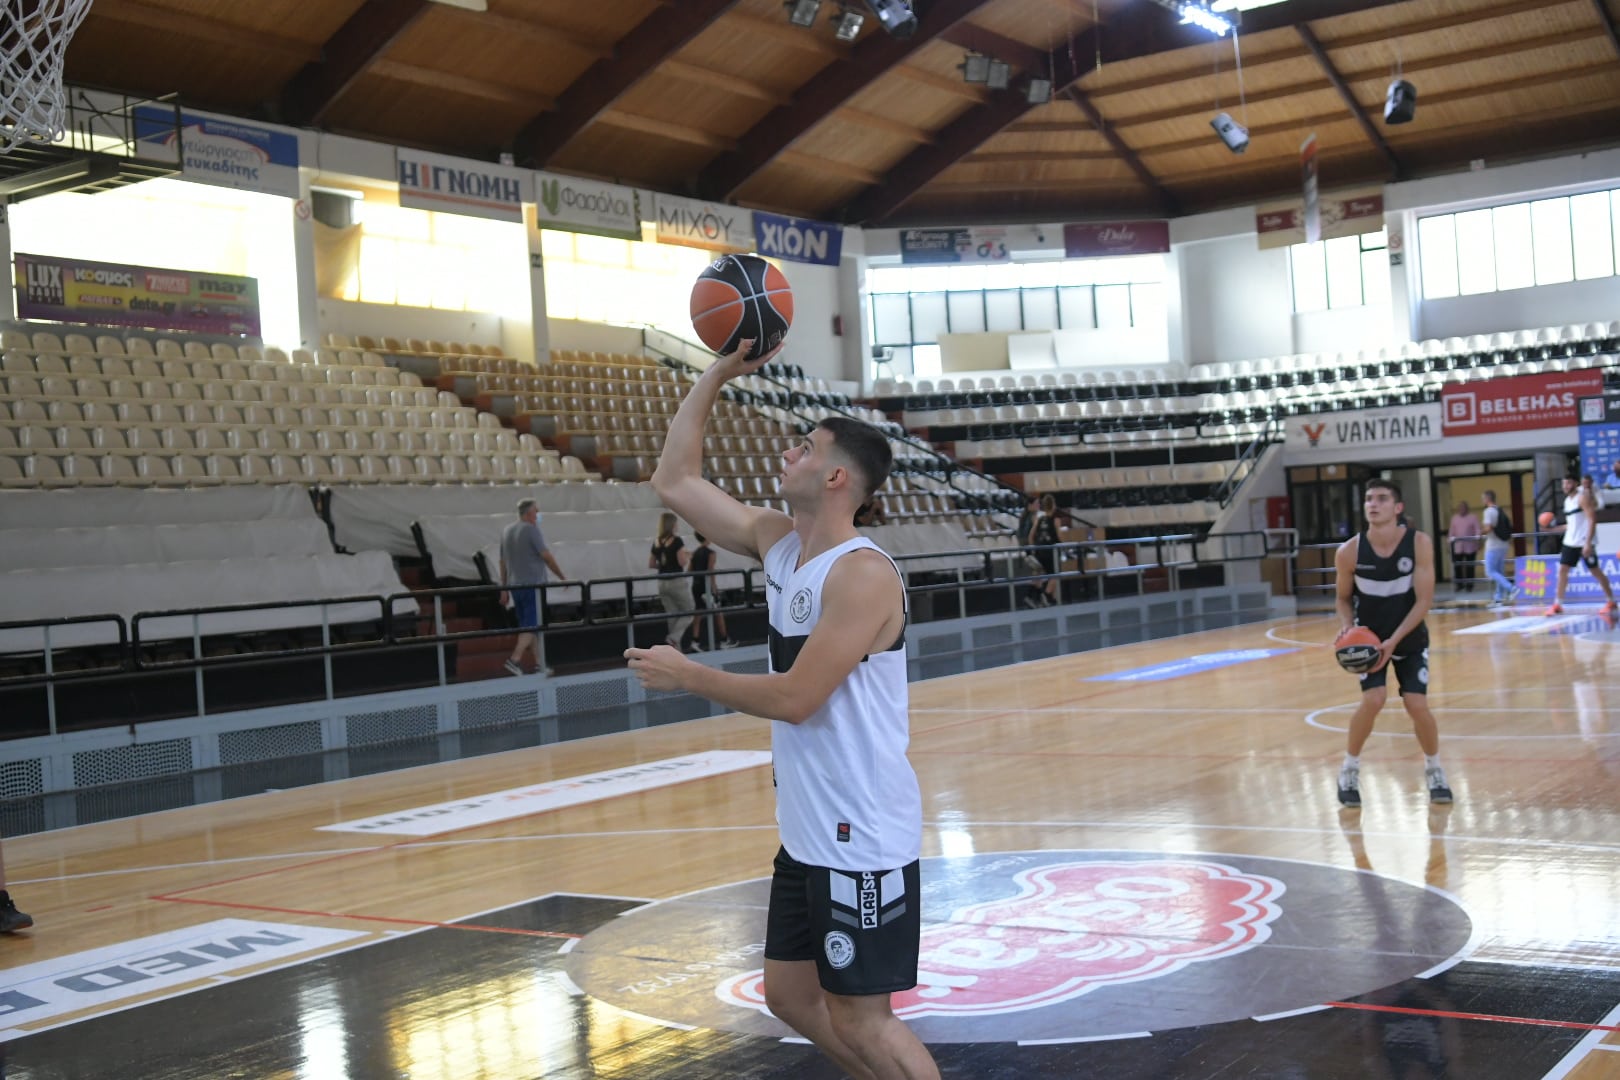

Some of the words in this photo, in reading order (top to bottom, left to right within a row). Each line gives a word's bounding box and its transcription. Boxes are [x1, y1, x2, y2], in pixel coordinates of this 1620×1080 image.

[183, 156, 259, 180] ευκαδίτης
[27, 263, 62, 288] LUX
[1480, 392, 1575, 415] BELEHAS
[1336, 414, 1431, 444] VANTANA
[53, 930, 305, 993] MED
[616, 972, 698, 995] 1932
